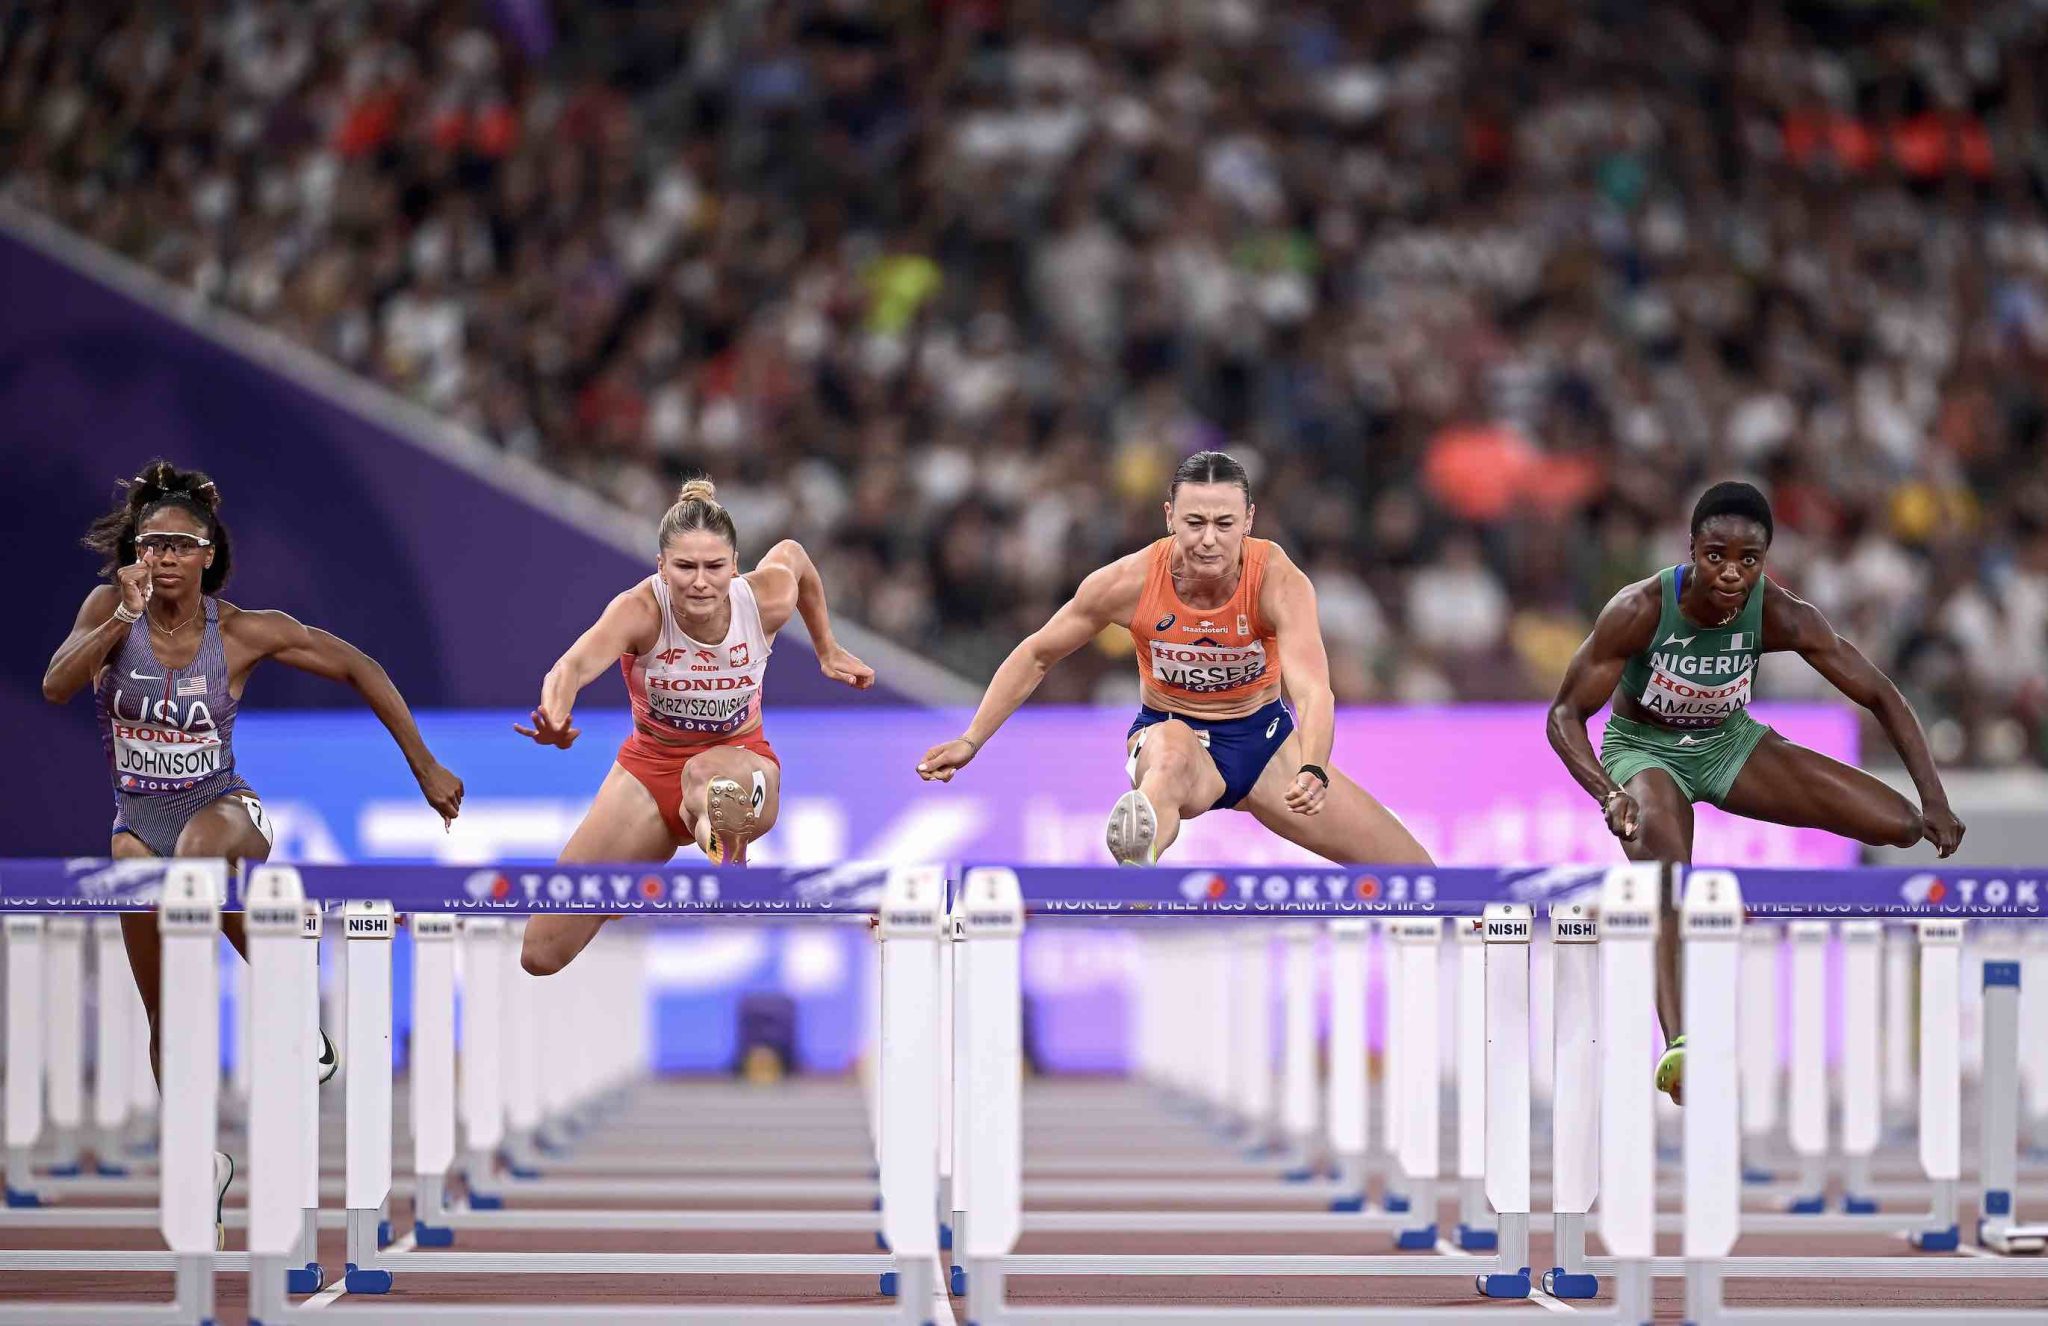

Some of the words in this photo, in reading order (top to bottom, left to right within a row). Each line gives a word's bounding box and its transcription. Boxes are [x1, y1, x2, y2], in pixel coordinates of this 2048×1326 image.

[656, 648, 687, 665] 4F
[1153, 647, 1260, 662] HONDA
[1650, 651, 1758, 675] NIGERIA
[690, 664, 720, 672] ORLEN
[1160, 661, 1260, 686] VISSER
[648, 675, 756, 692] HONDA
[1653, 671, 1750, 699] HONDA
[113, 689, 217, 730] USA
[1648, 693, 1747, 715] AMUSAN
[120, 748, 215, 775] JOHNSON
[251, 800, 262, 829] 7
[1956, 878, 2048, 905] TOK
[349, 919, 387, 931] NISHI
[1488, 923, 1527, 936] NISHI
[1557, 923, 1597, 936] NISHI
